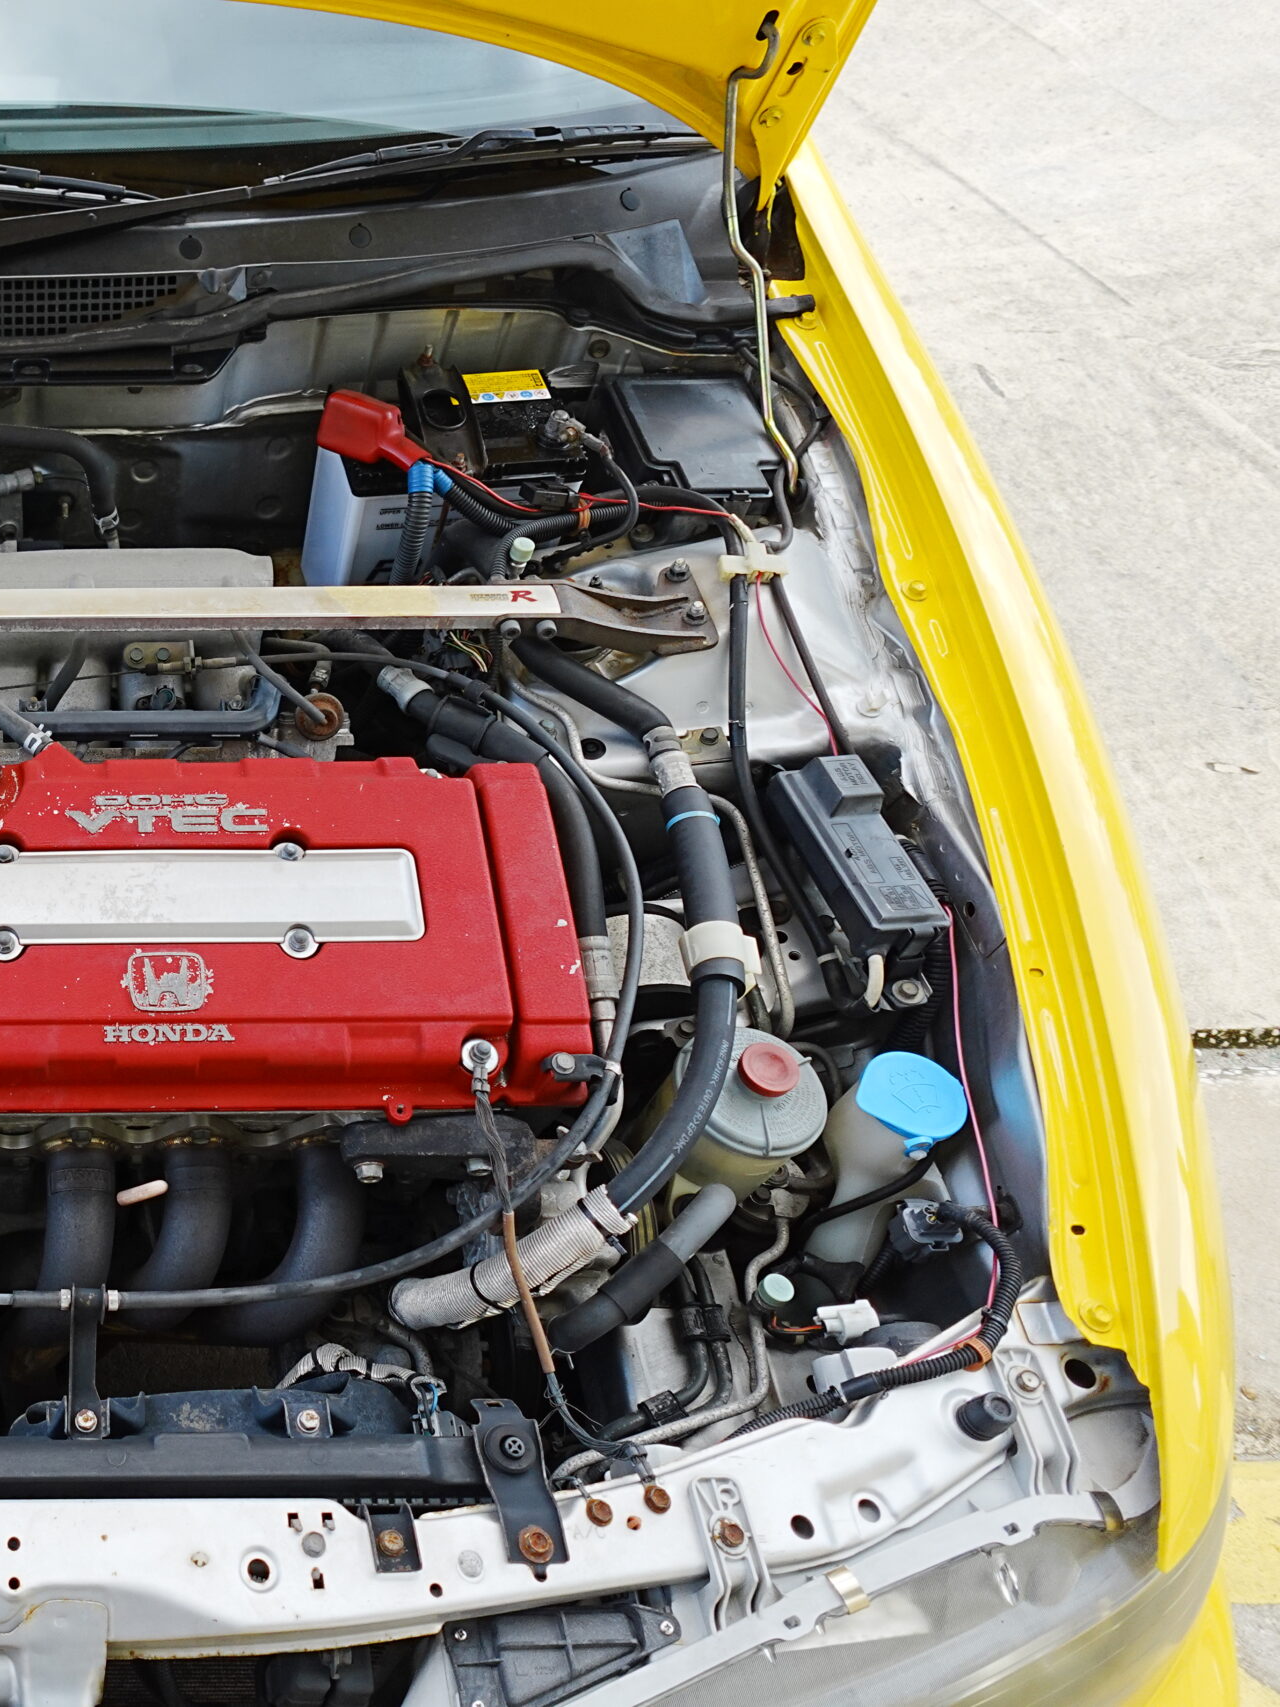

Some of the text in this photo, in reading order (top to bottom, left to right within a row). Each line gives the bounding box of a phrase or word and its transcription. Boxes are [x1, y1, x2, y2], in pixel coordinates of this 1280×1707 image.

[509, 590, 538, 602] R
[95, 793, 228, 806] DOHC
[65, 808, 269, 834] VTEC
[103, 1024, 235, 1042] HONDA
